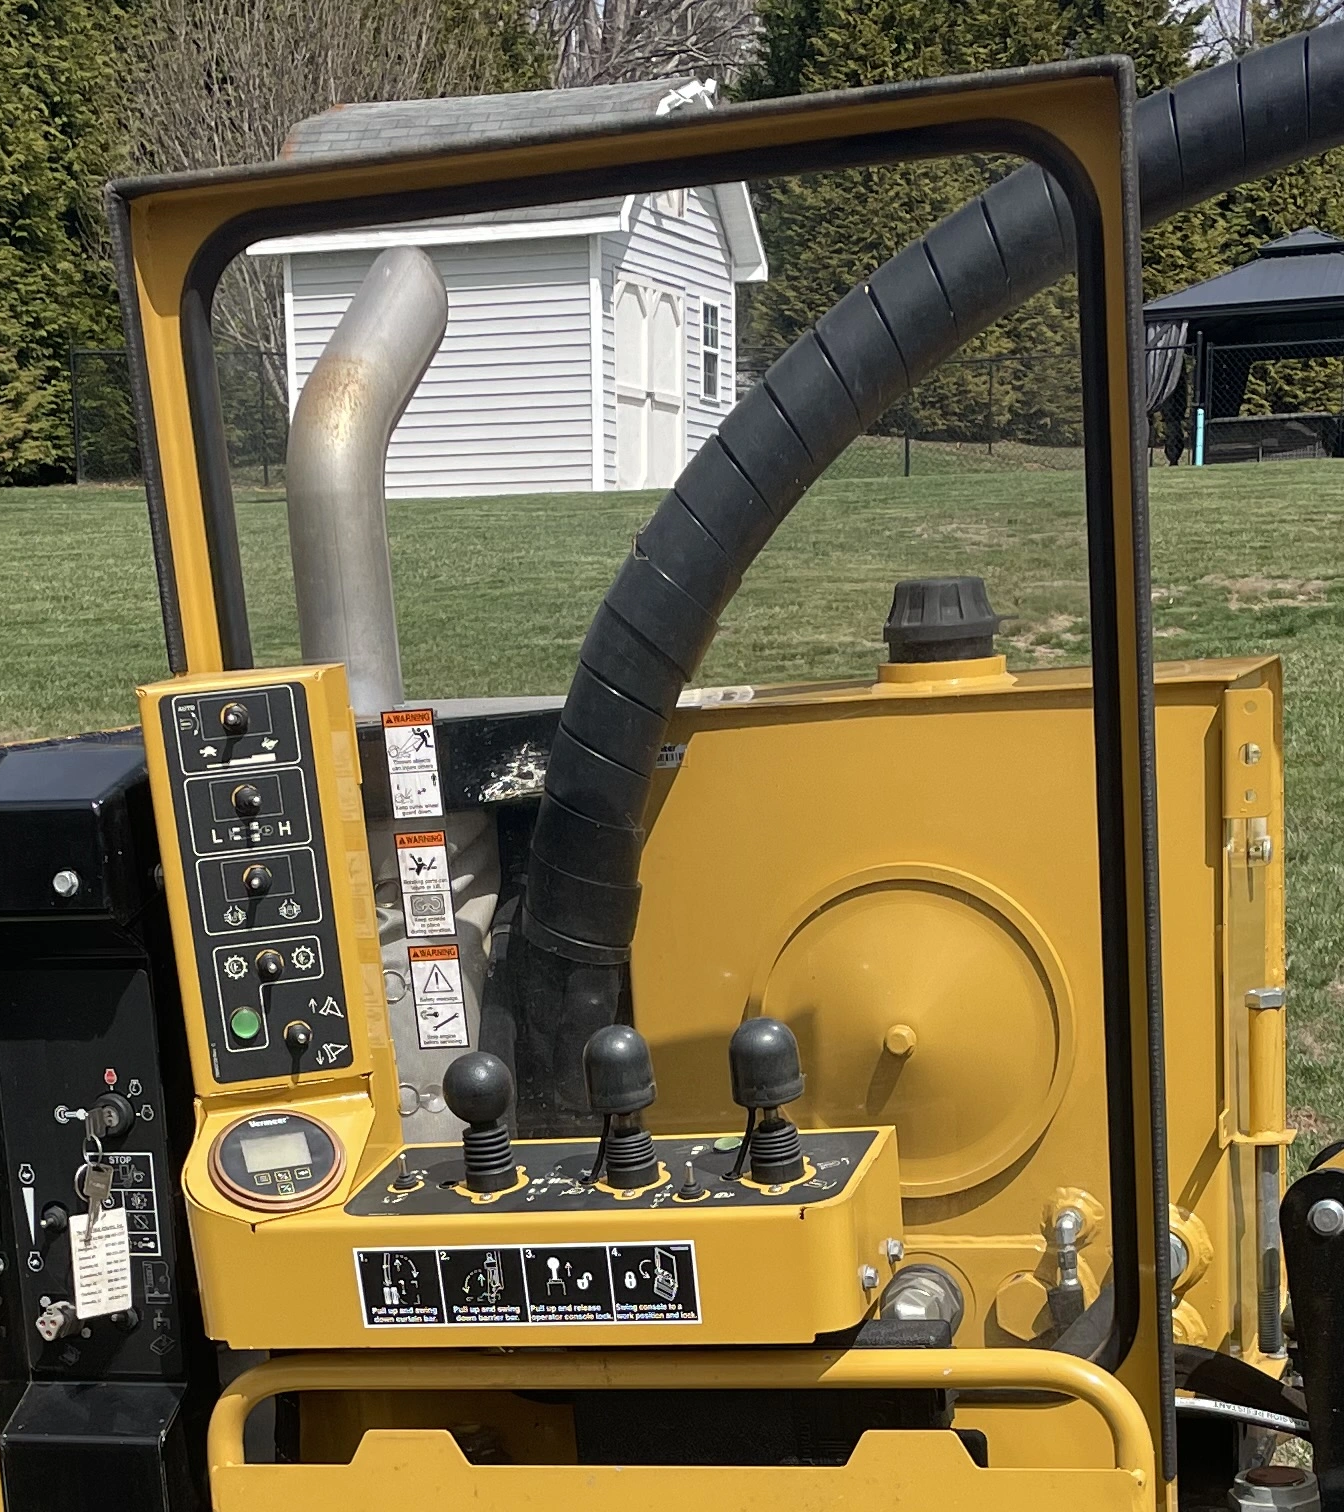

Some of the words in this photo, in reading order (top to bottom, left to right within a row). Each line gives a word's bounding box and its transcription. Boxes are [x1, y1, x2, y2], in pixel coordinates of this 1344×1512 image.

[394, 712, 430, 723] WARNING
[211, 828, 223, 844] L
[278, 820, 292, 836] H
[406, 835, 443, 845] WARNING
[419, 948, 456, 957] WARNING
[249, 1115, 288, 1128] Vermeer
[108, 1156, 132, 1165] STOP
[371, 1306, 387, 1315] Pull
[387, 1308, 398, 1316] up
[399, 1306, 414, 1314] and
[414, 1306, 438, 1316] swing
[452, 1305, 468, 1313] Pull
[469, 1306, 480, 1314] up
[481, 1305, 496, 1313] and
[497, 1304, 521, 1314] swing
[530, 1304, 545, 1312] Pull
[546, 1305, 557, 1313] up
[557, 1303, 573, 1312] and
[573, 1303, 602, 1312] release
[616, 1303, 638, 1312] Swing
[638, 1302, 668, 1311] console
[667, 1303, 676, 1311] to
[373, 1315, 395, 1323] down
[455, 1314, 477, 1322] down
[478, 1314, 504, 1322] barrier
[531, 1313, 563, 1322] operator
[564, 1312, 595, 1320] console
[595, 1312, 614, 1320] lock.
[635, 1311, 665, 1321] position
[665, 1311, 680, 1319] and
[680, 1311, 698, 1319] lock.
[1214, 1400, 1265, 1418] RESISTANT
